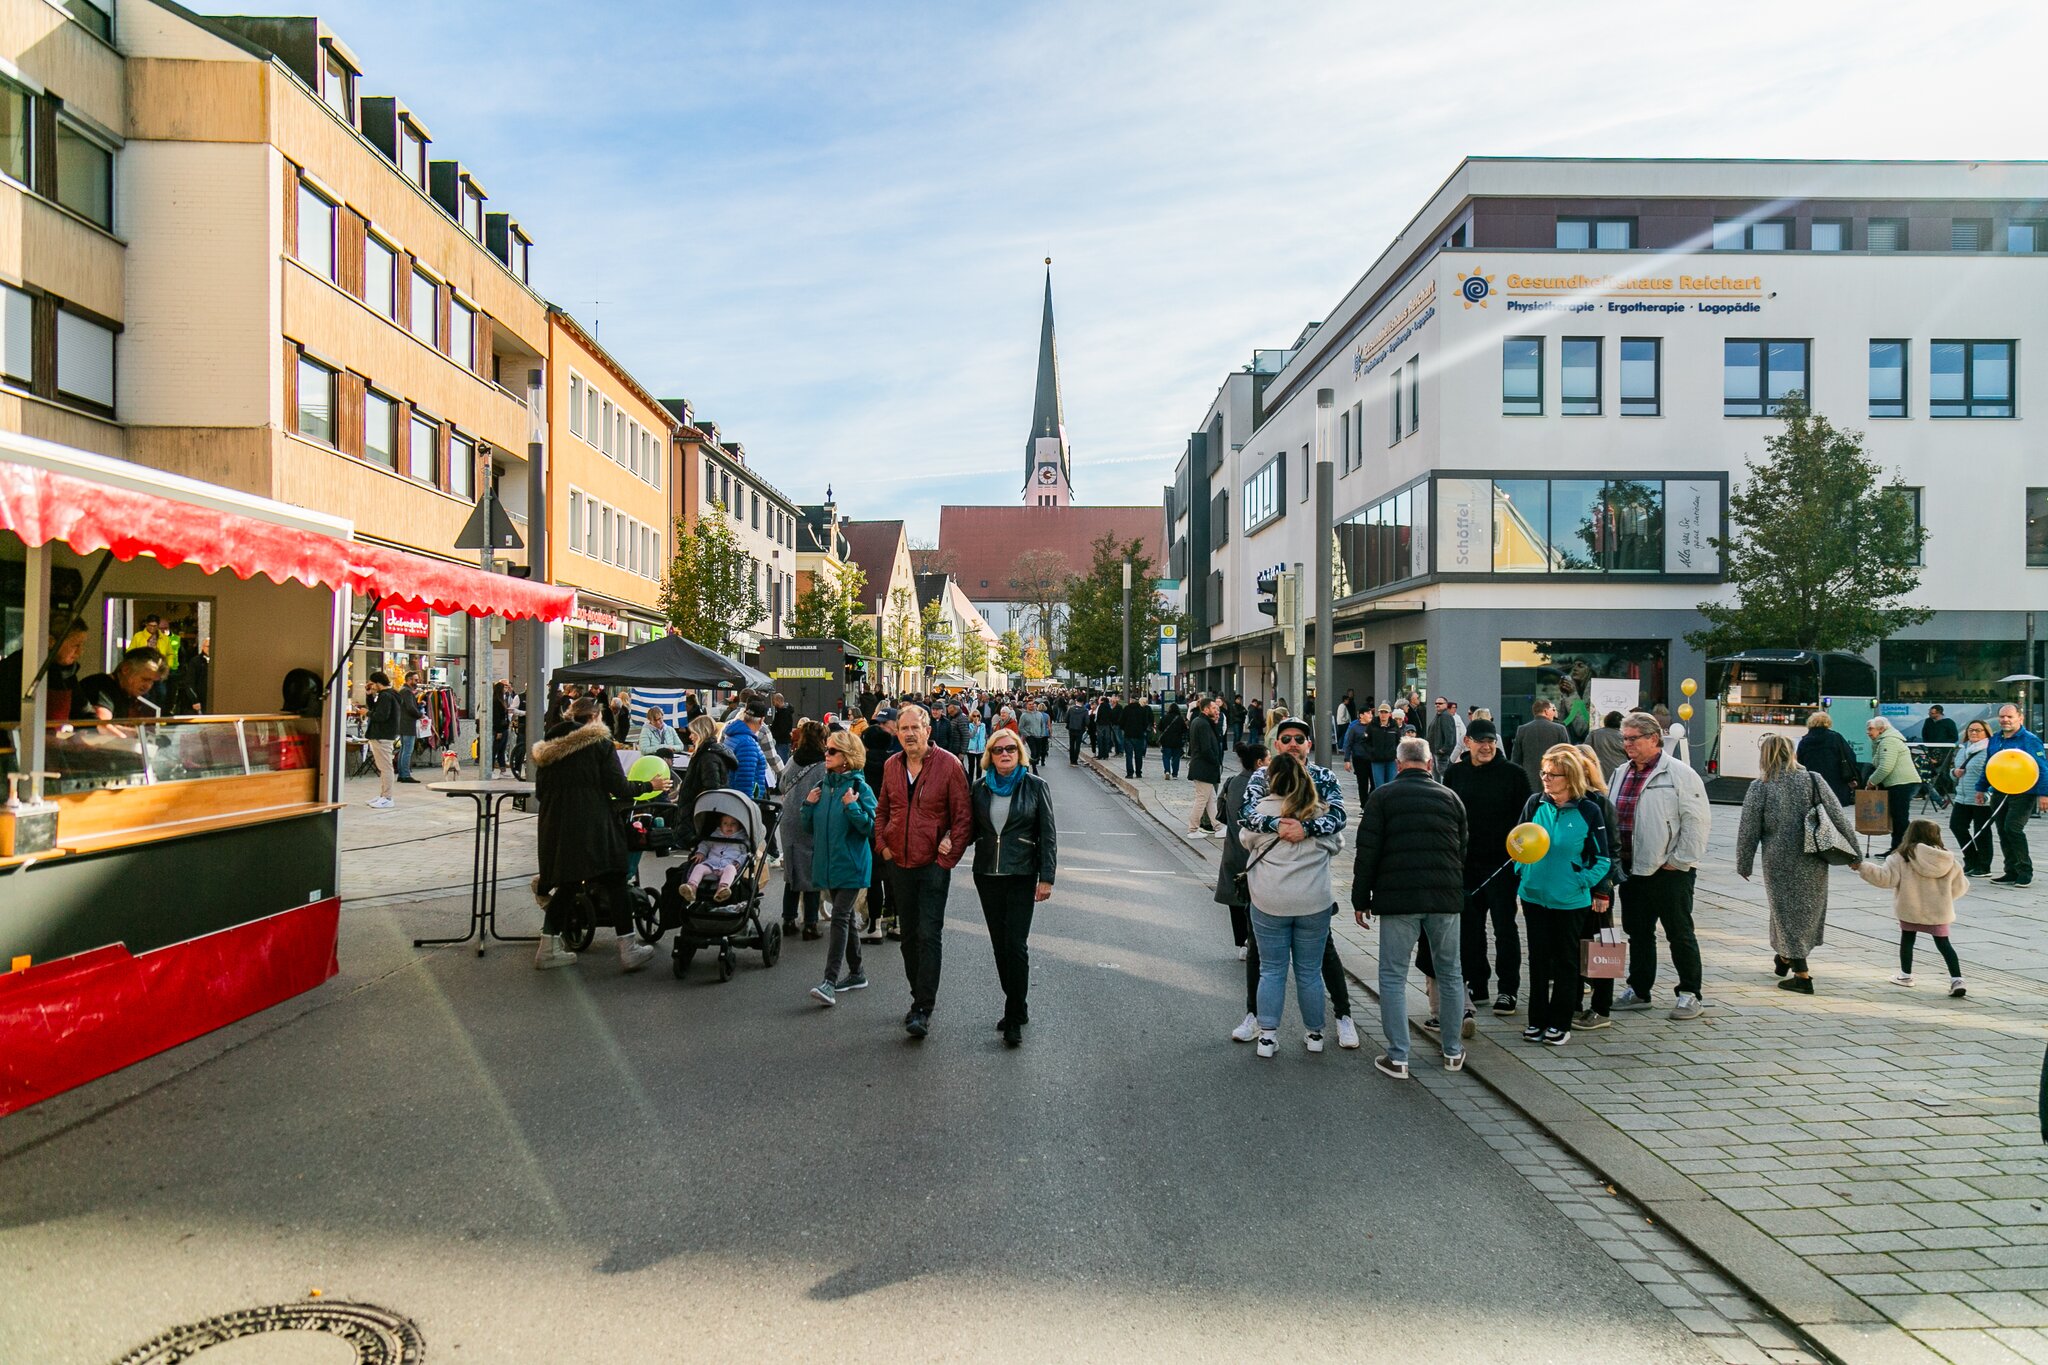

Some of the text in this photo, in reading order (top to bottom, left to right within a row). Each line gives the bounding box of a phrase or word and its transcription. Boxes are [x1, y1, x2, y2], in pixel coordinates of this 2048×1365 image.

[1507, 273, 1762, 290] Gesundheitshaus Reichart
[1507, 301, 1761, 315] Physiotherapie Ergotherapie Logopädie
[1457, 503, 1469, 565] Schöffel
[777, 668, 825, 677] PATATA LOCA
